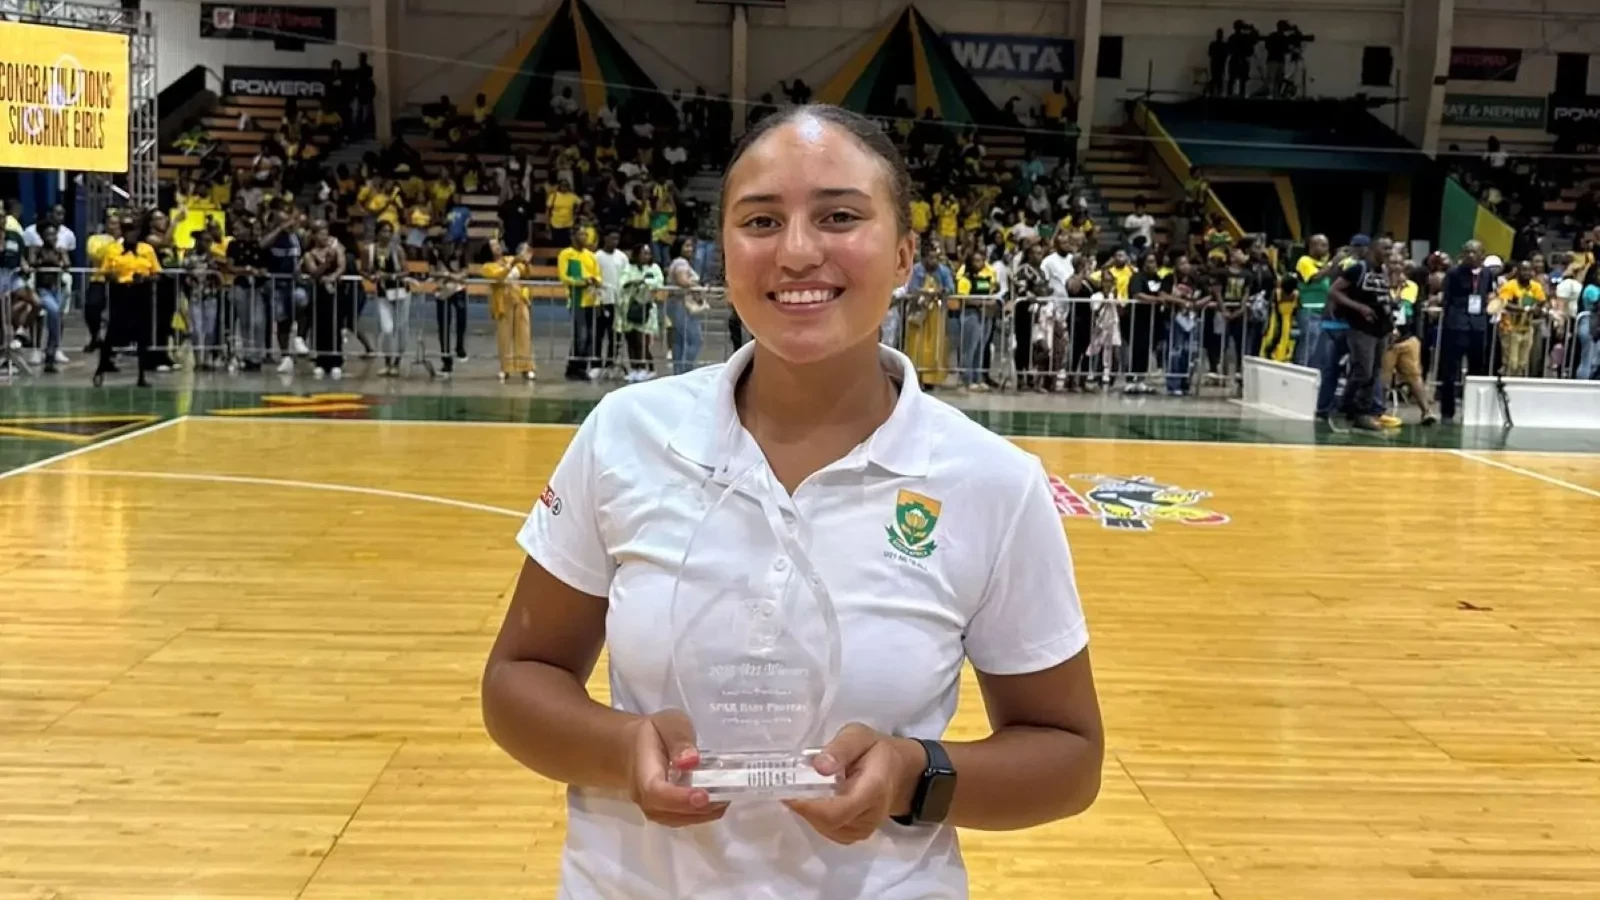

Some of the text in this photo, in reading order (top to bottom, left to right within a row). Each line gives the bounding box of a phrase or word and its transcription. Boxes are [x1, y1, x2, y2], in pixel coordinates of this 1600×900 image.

[950, 40, 1062, 73] WATA
[0, 62, 113, 110] CONGRATULATIONS
[8, 105, 105, 149] SUNSHINE GIRLS
[1482, 105, 1541, 119] NEPHEW
